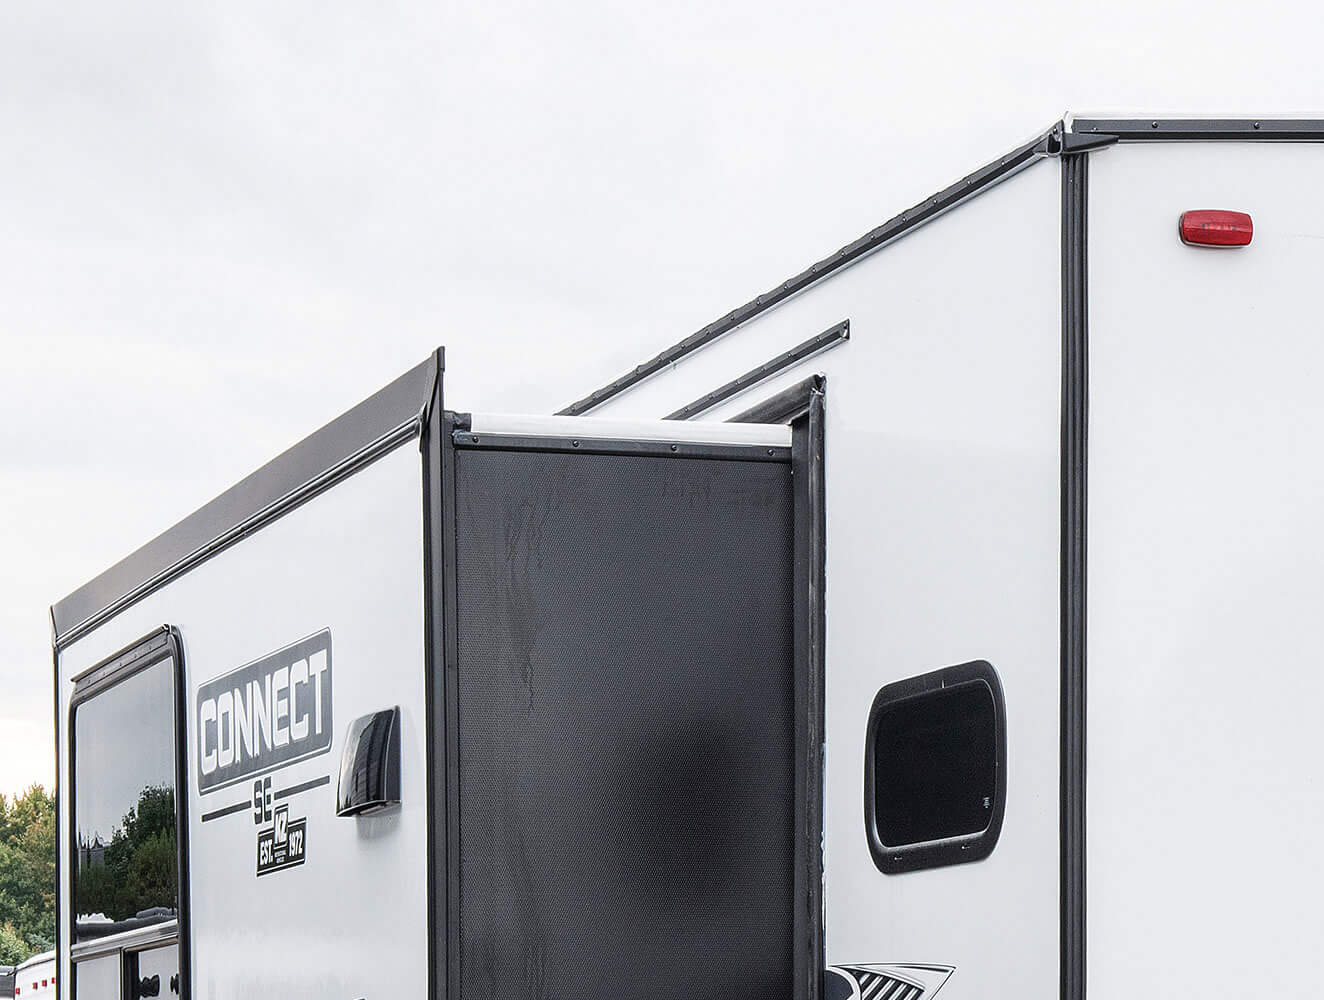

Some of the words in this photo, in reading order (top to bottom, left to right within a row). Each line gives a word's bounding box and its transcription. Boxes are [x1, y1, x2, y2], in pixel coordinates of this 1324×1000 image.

[199, 648, 328, 776] CONNECT
[253, 775, 273, 825] SE
[259, 838, 274, 866] EST.
[288, 829, 304, 857] 1972
[275, 810, 288, 844] KZ
